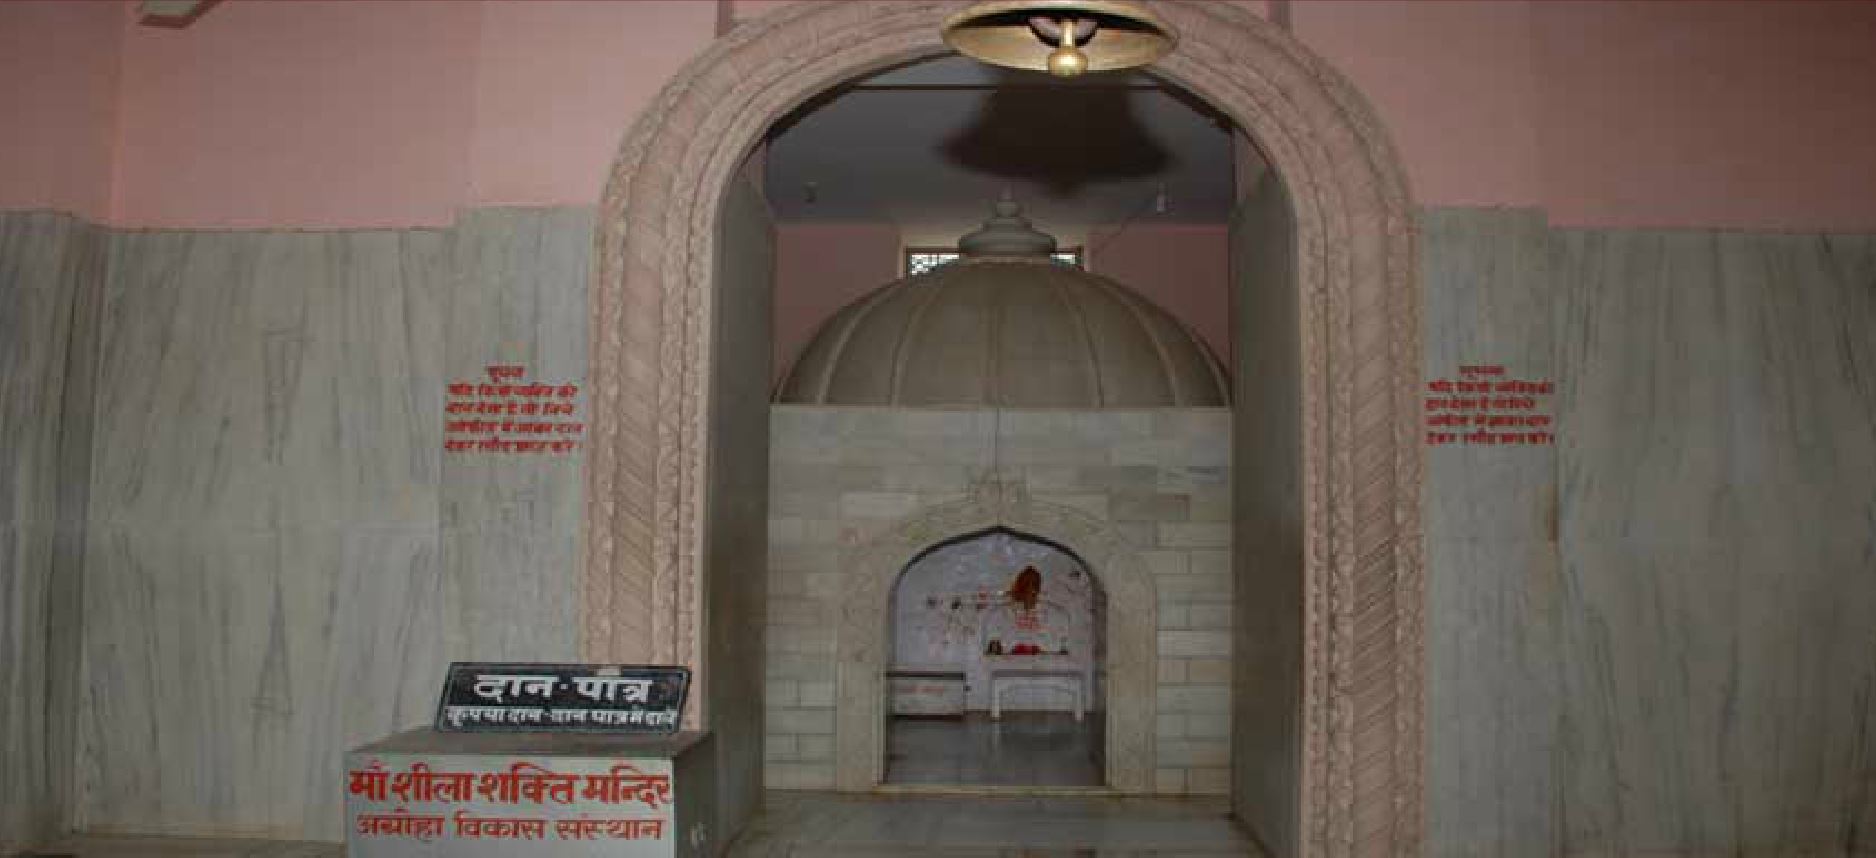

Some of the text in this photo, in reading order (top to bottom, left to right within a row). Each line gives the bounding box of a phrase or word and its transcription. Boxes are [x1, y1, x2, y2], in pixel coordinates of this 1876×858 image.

[391, 761, 475, 804] शीला
[477, 762, 580, 804] शक्ति
[582, 765, 672, 809] मन्दिर
[454, 809, 548, 841] विकास
[555, 812, 666, 841] संस्थान
